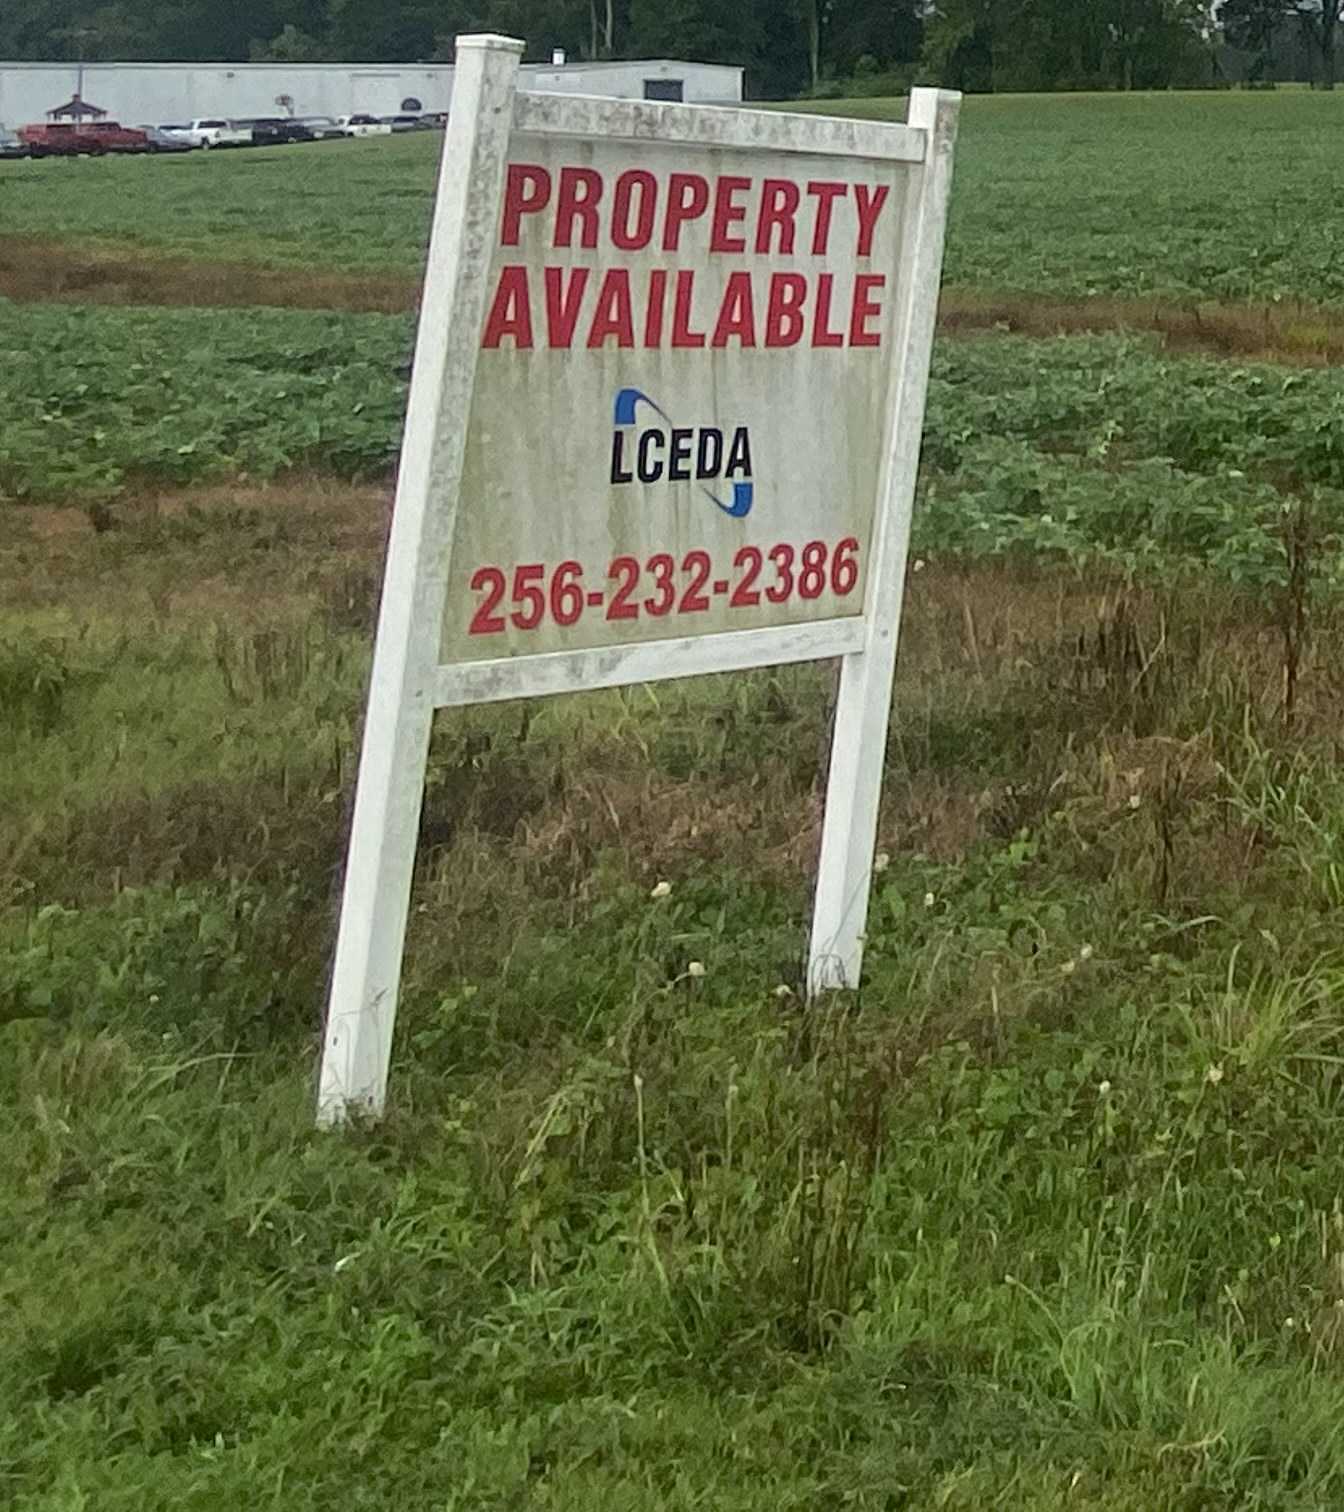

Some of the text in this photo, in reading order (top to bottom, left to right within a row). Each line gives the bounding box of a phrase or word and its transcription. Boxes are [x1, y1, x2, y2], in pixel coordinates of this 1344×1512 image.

[500, 163, 891, 257] PROPERTY
[481, 266, 886, 349] AVAILABLE
[610, 427, 753, 485] LCEDA
[468, 537, 860, 636] 256-232-2386
